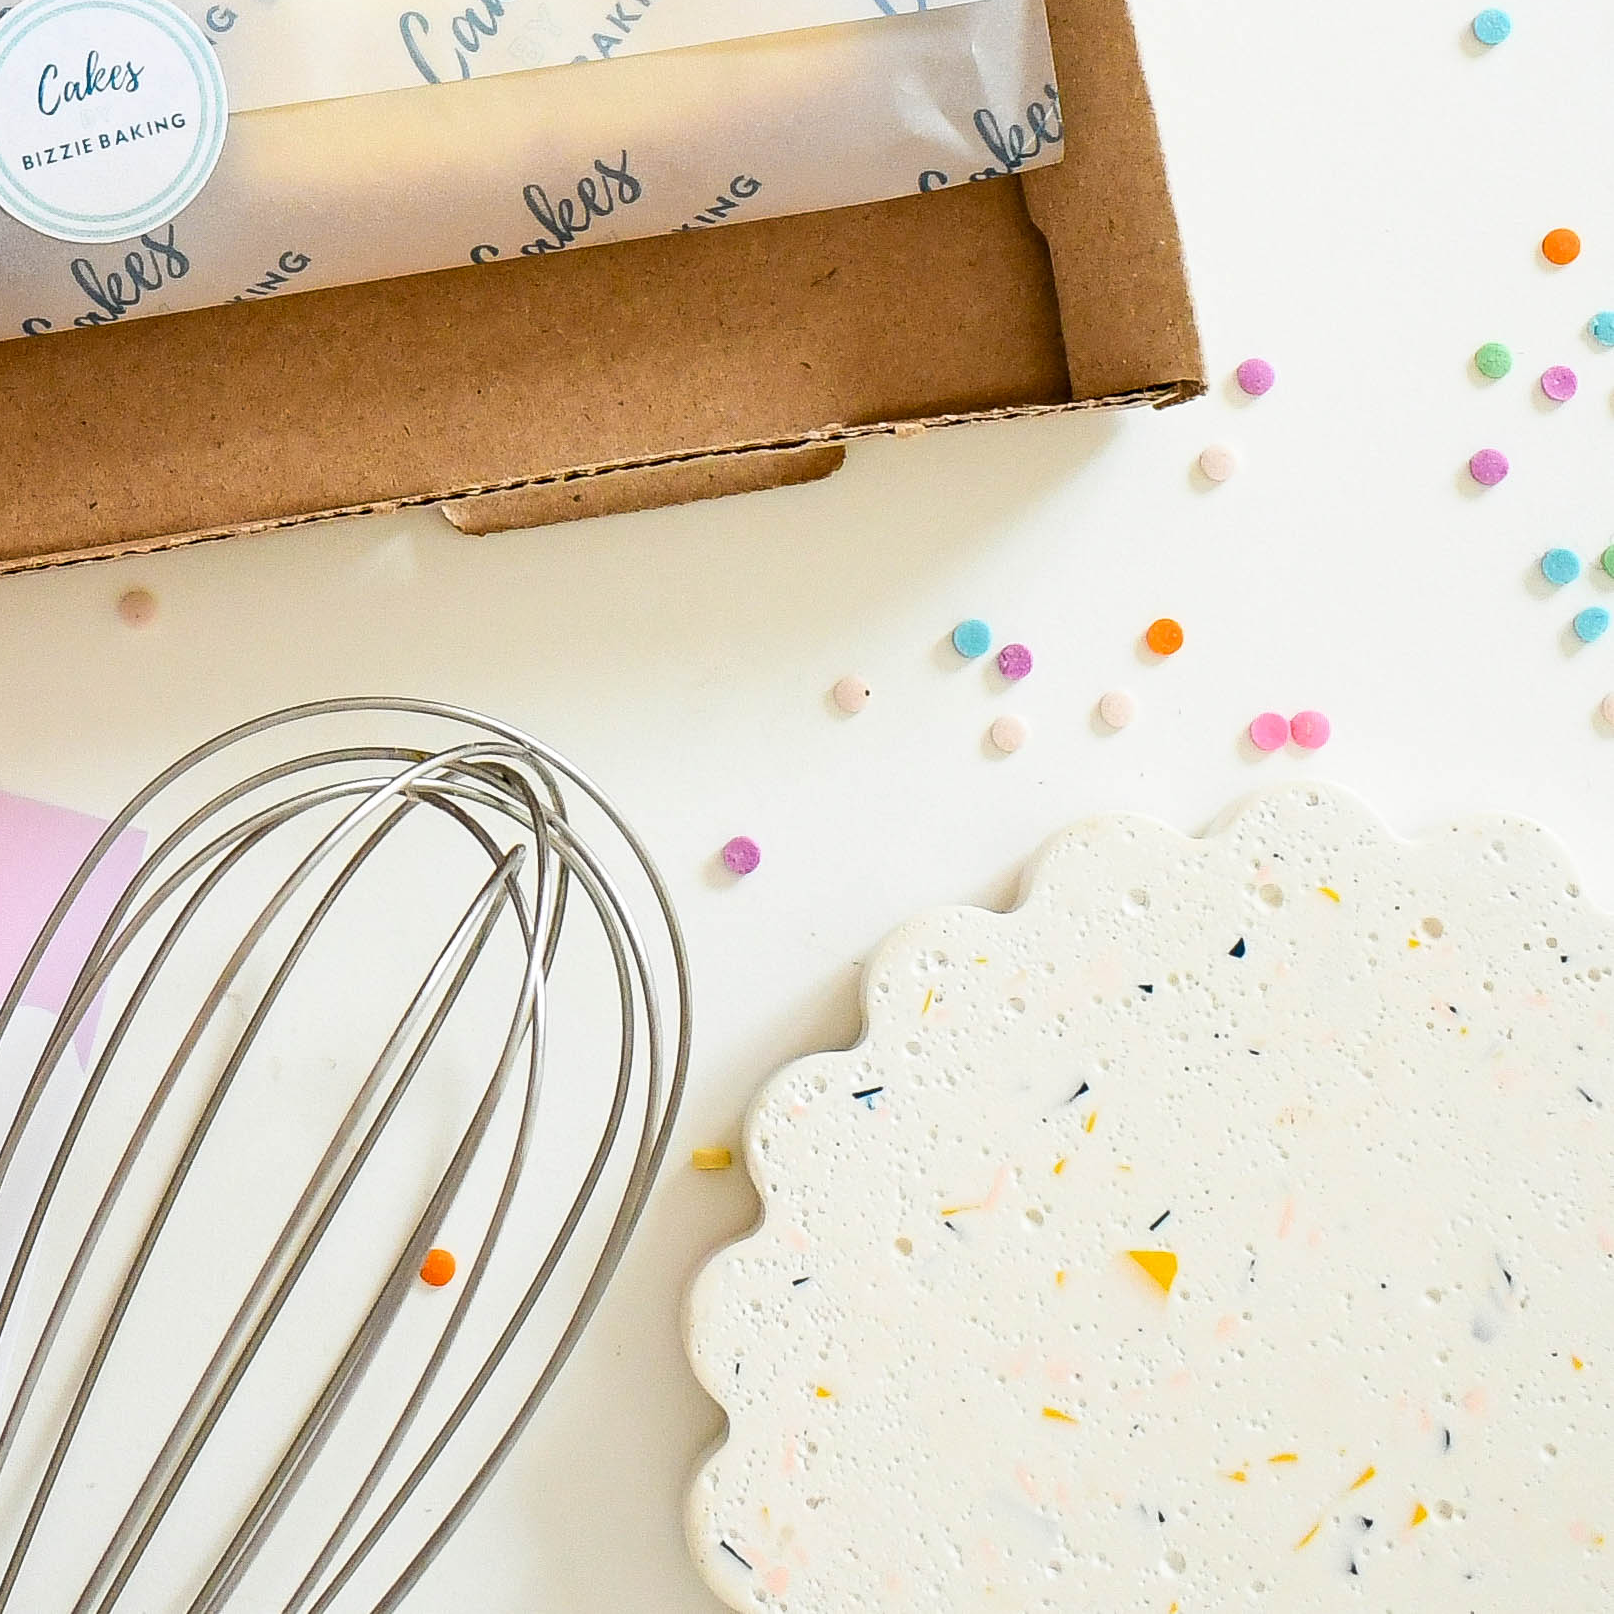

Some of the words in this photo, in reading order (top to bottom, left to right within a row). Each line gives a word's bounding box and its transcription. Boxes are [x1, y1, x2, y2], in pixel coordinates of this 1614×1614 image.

[38, 50, 145, 115] Cakes
[22, 138, 92, 171] BIZZIE
[99, 113, 186, 149] BAKING
